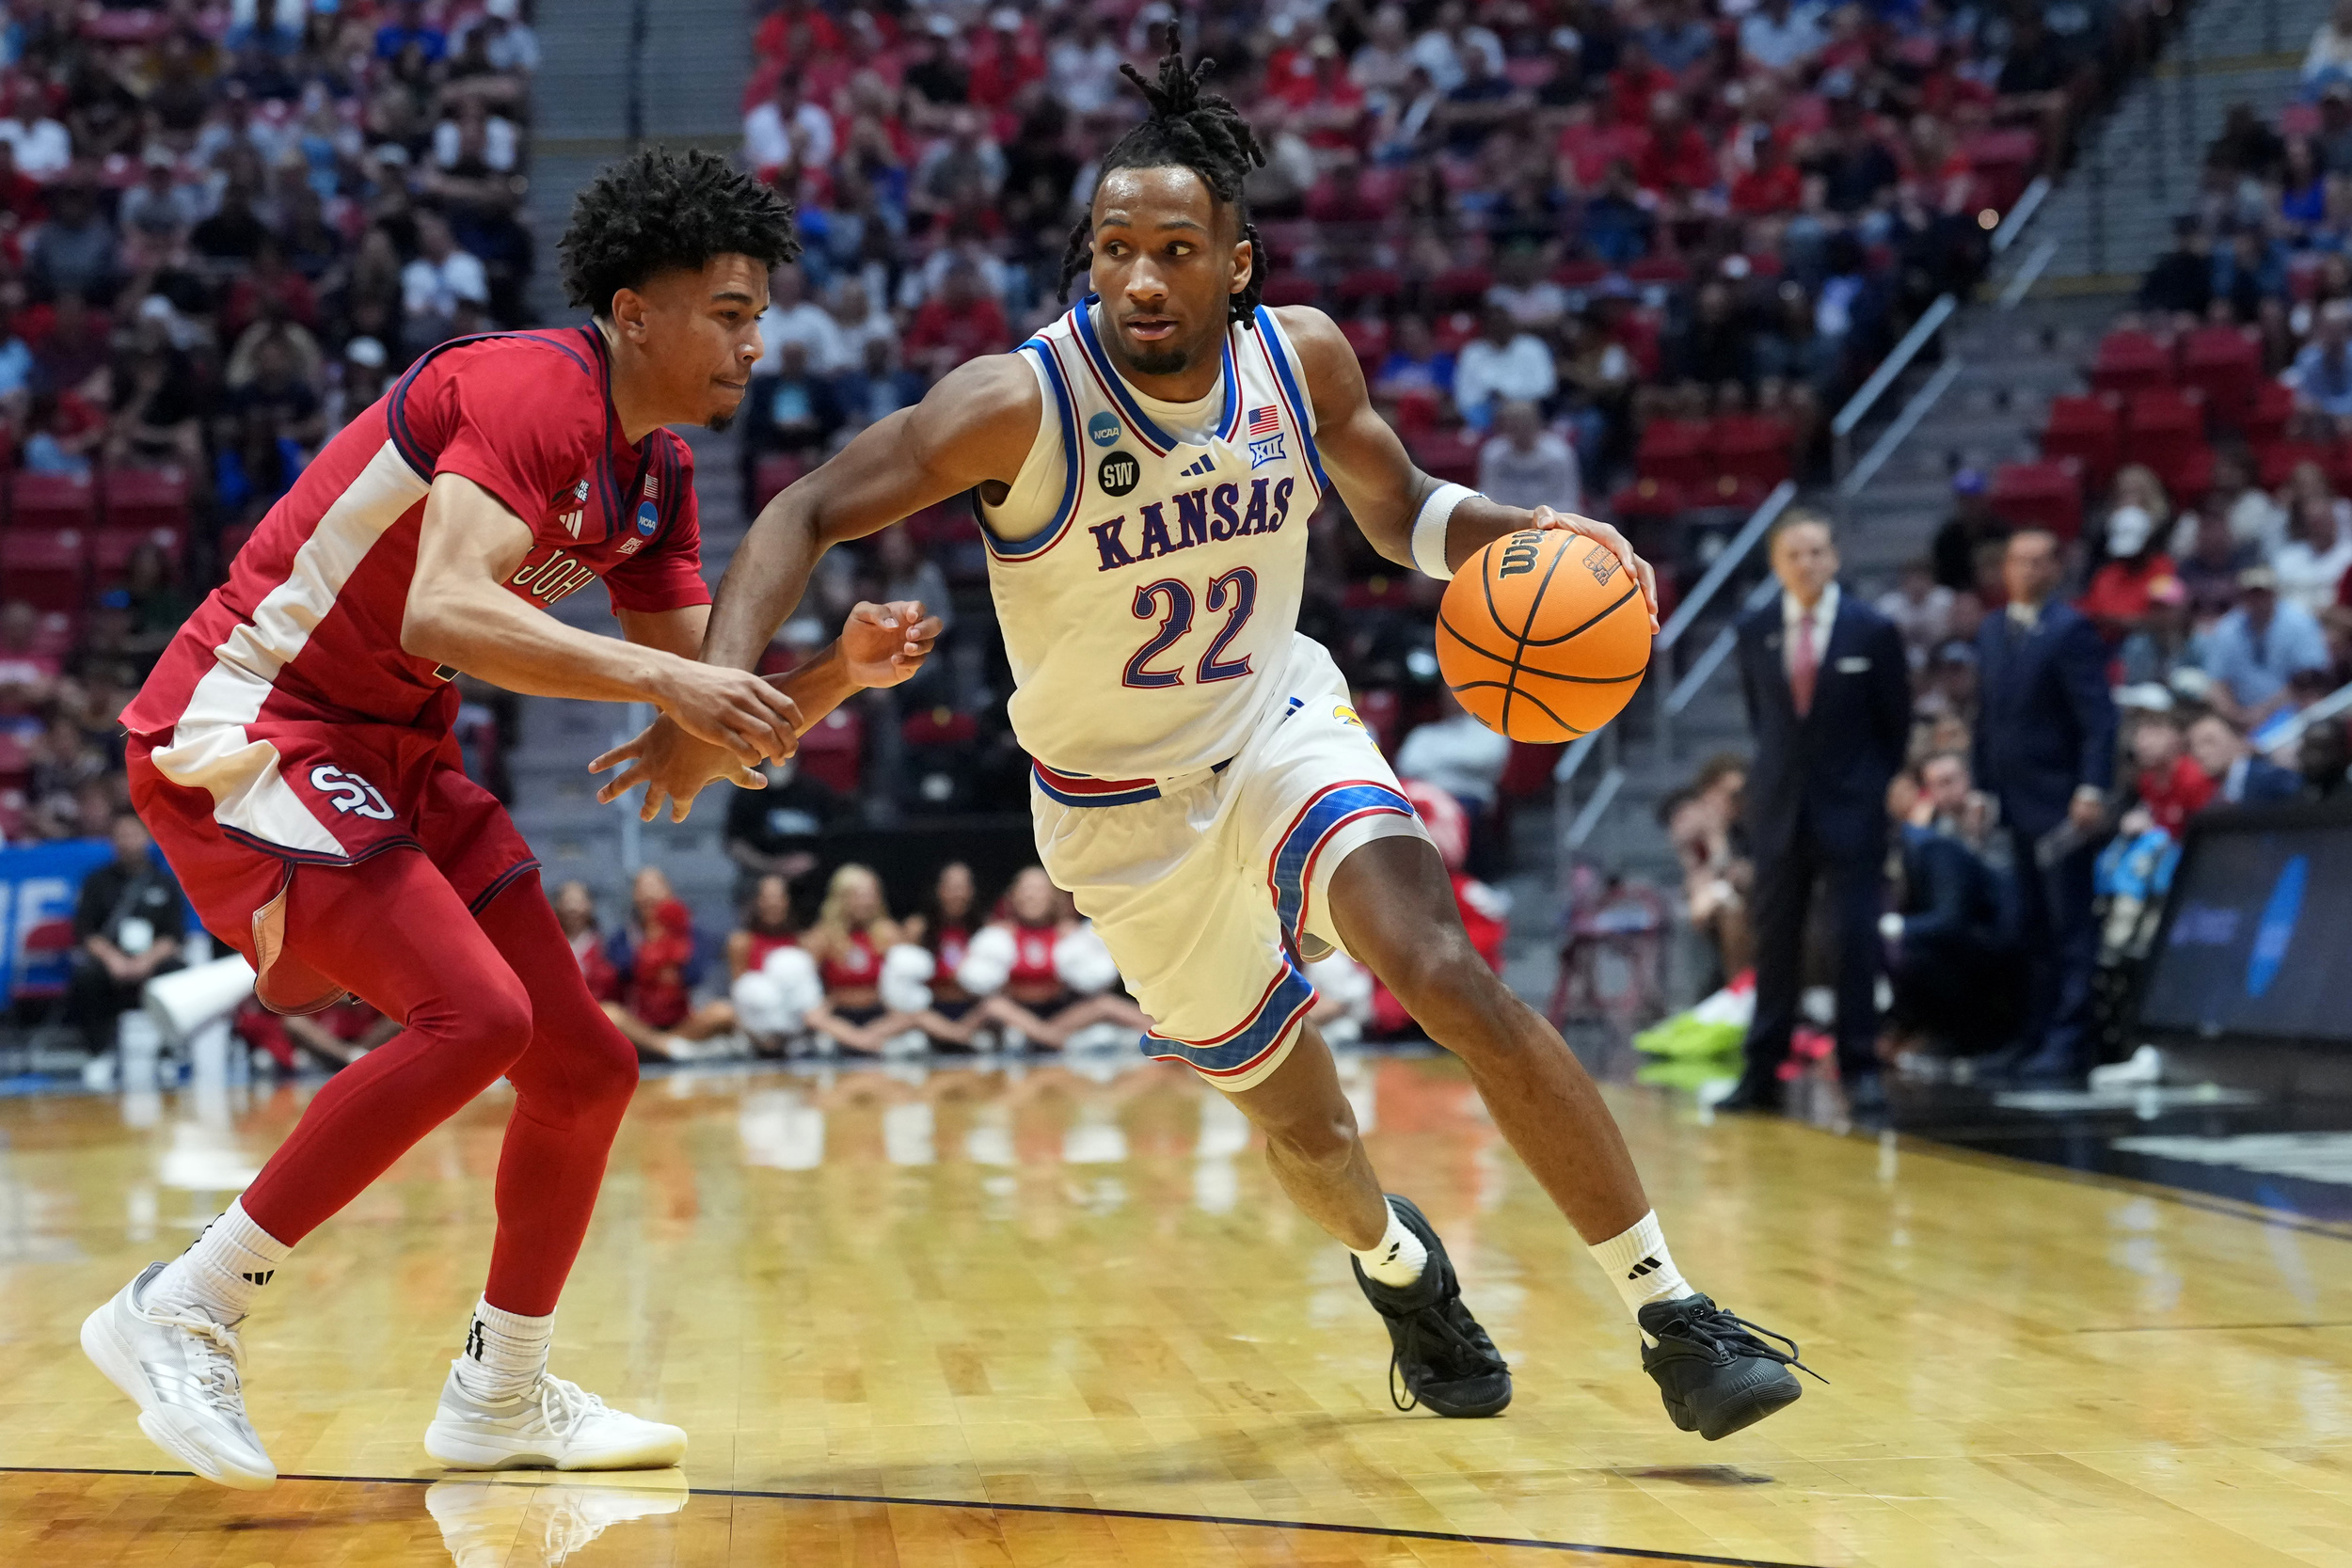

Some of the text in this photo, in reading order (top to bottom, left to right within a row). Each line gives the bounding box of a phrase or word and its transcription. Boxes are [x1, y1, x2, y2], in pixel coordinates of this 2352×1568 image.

[1093, 427, 1120, 440] NCAA
[1248, 433, 1287, 470] XII
[1103, 462, 1134, 488] SW
[638, 515, 657, 531] NCAA
[1088, 476, 1295, 572] KANSAS
[511, 548, 596, 605] JOH
[1121, 566, 1258, 689] 22
